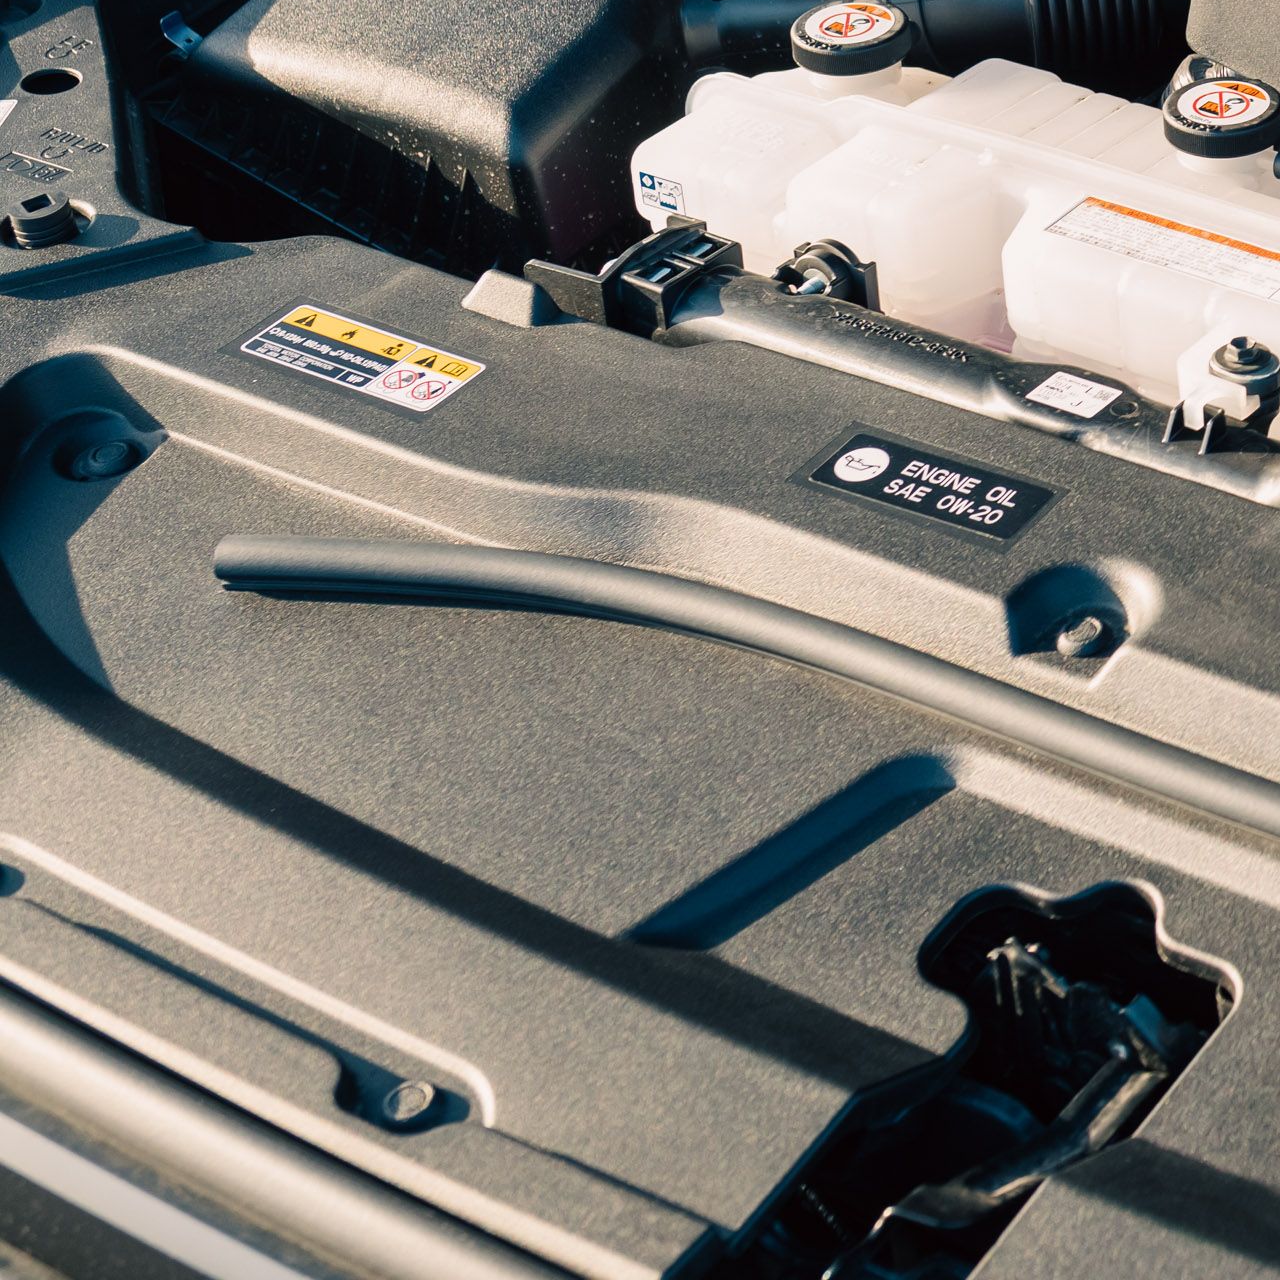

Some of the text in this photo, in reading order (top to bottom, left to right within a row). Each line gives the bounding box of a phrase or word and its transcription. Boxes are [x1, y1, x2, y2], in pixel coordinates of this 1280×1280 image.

[883, 479, 1005, 525] SAE 0W-20
[901, 460, 1018, 508] ENGINE OIL
